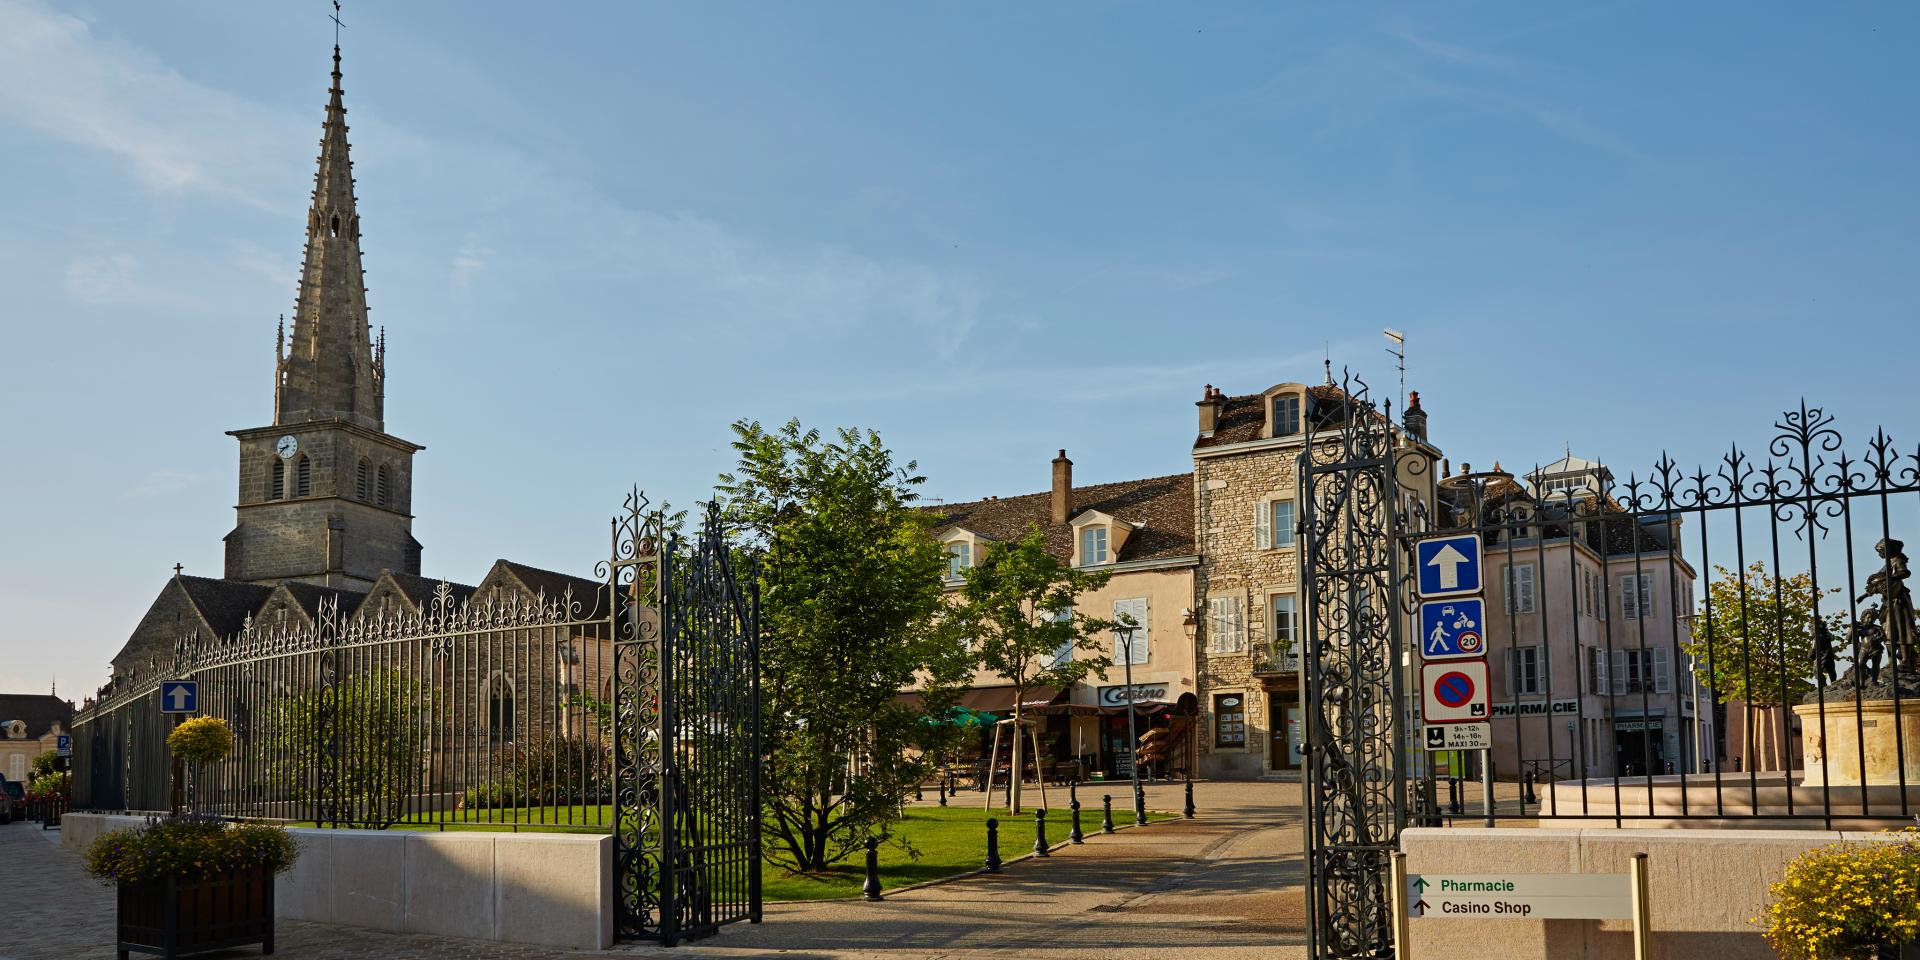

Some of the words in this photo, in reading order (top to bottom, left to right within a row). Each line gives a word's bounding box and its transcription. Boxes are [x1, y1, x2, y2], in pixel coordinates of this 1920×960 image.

[1463, 637, 1476, 646] 20
[1104, 685, 1166, 704] Casino
[1441, 879, 1514, 892] Pharmacie
[1442, 901, 1490, 914] Casino
[1494, 901, 1531, 917] Shop
